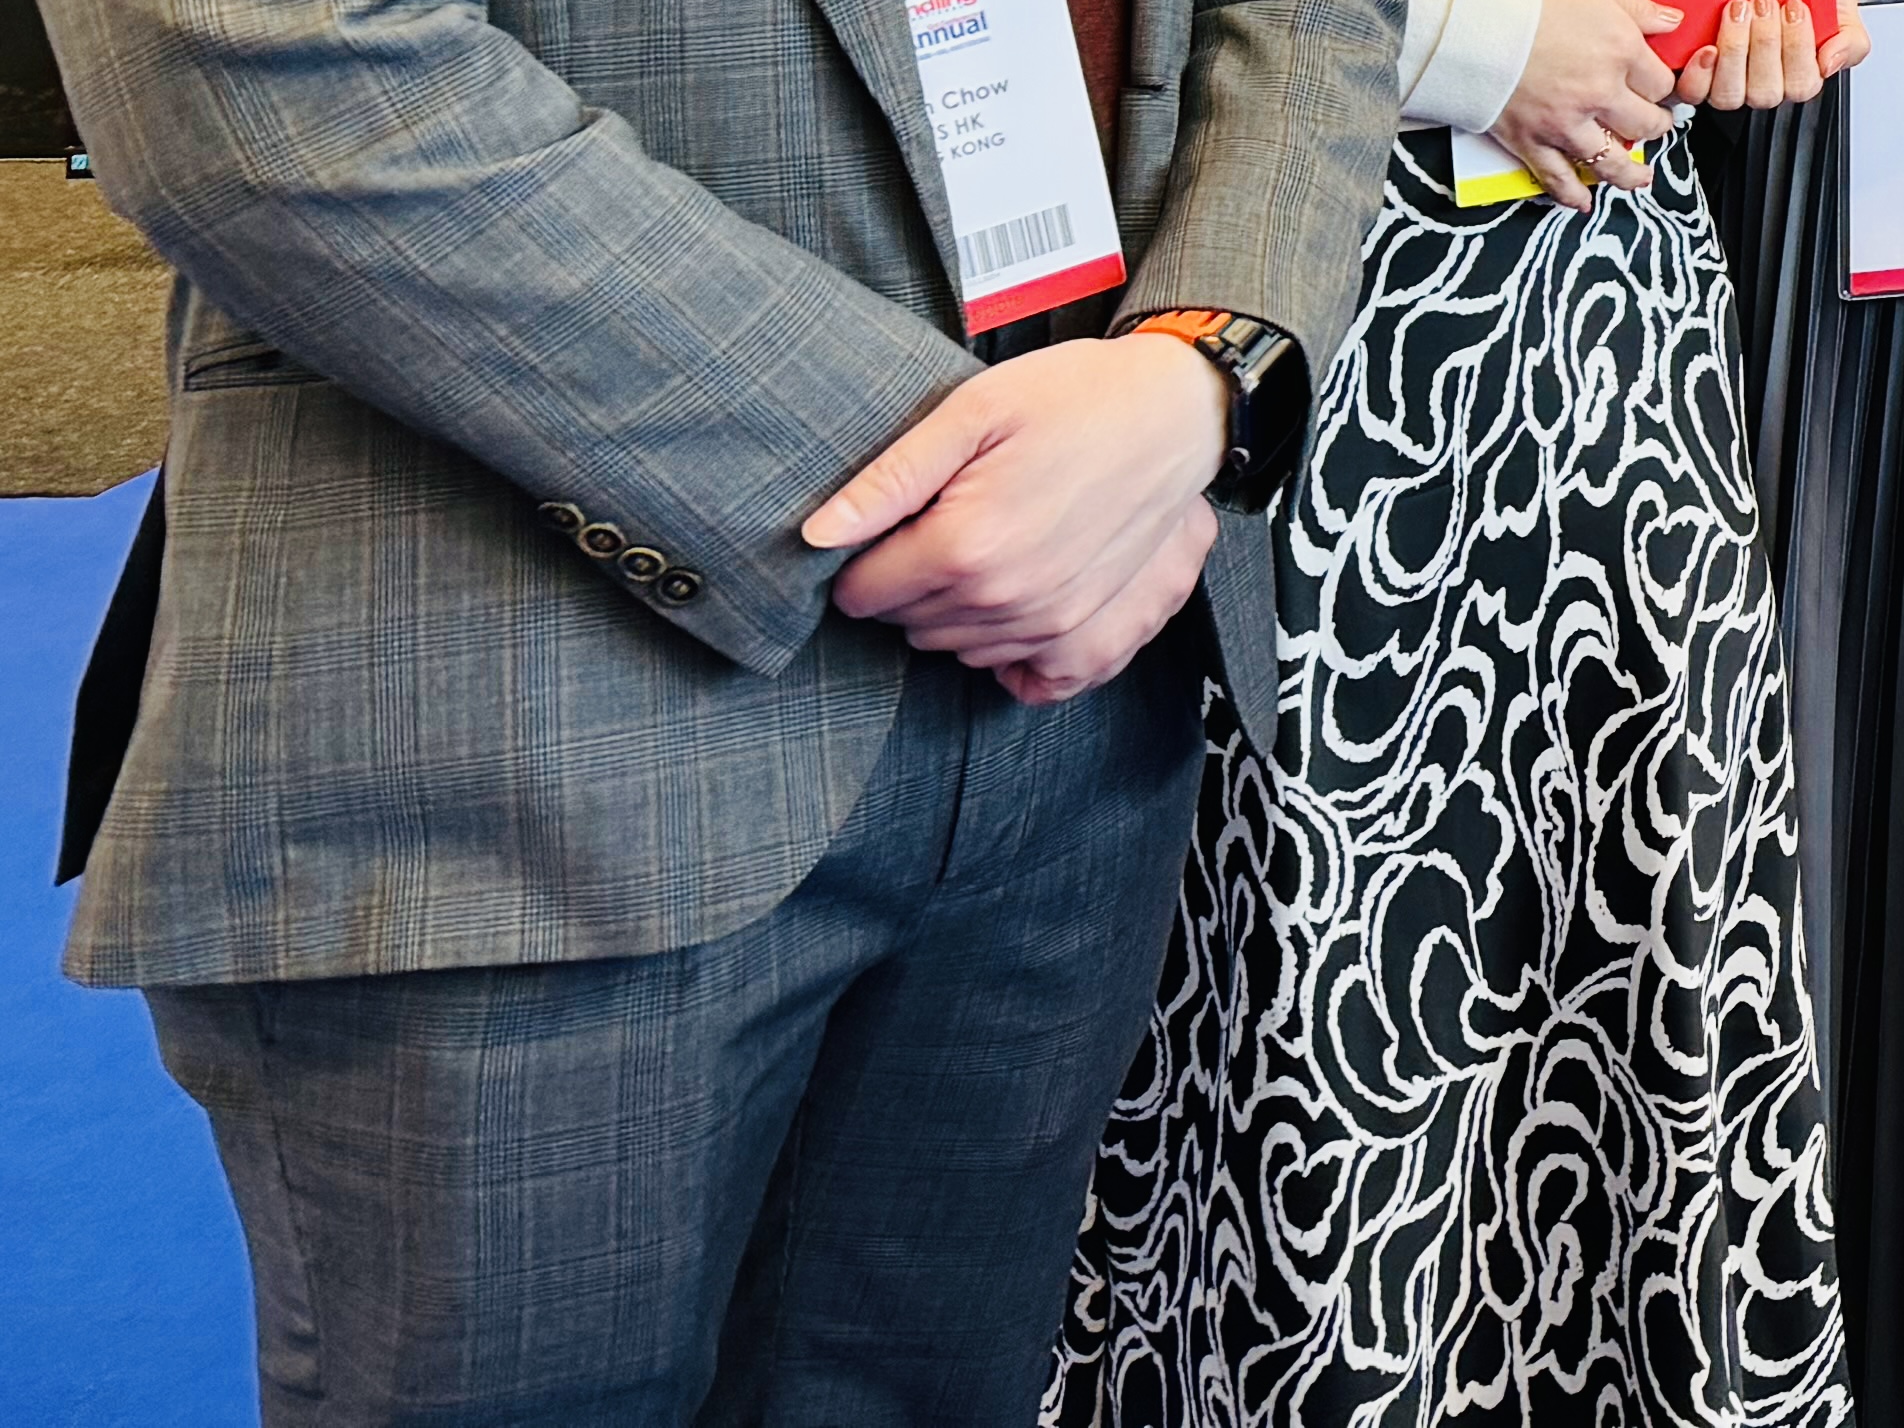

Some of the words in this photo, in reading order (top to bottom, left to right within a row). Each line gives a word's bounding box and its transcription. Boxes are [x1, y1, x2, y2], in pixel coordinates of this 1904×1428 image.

[916, 10, 989, 49] nnual
[941, 79, 1009, 109] Chow
[955, 112, 985, 136] HK
[951, 131, 1006, 160] KONG
